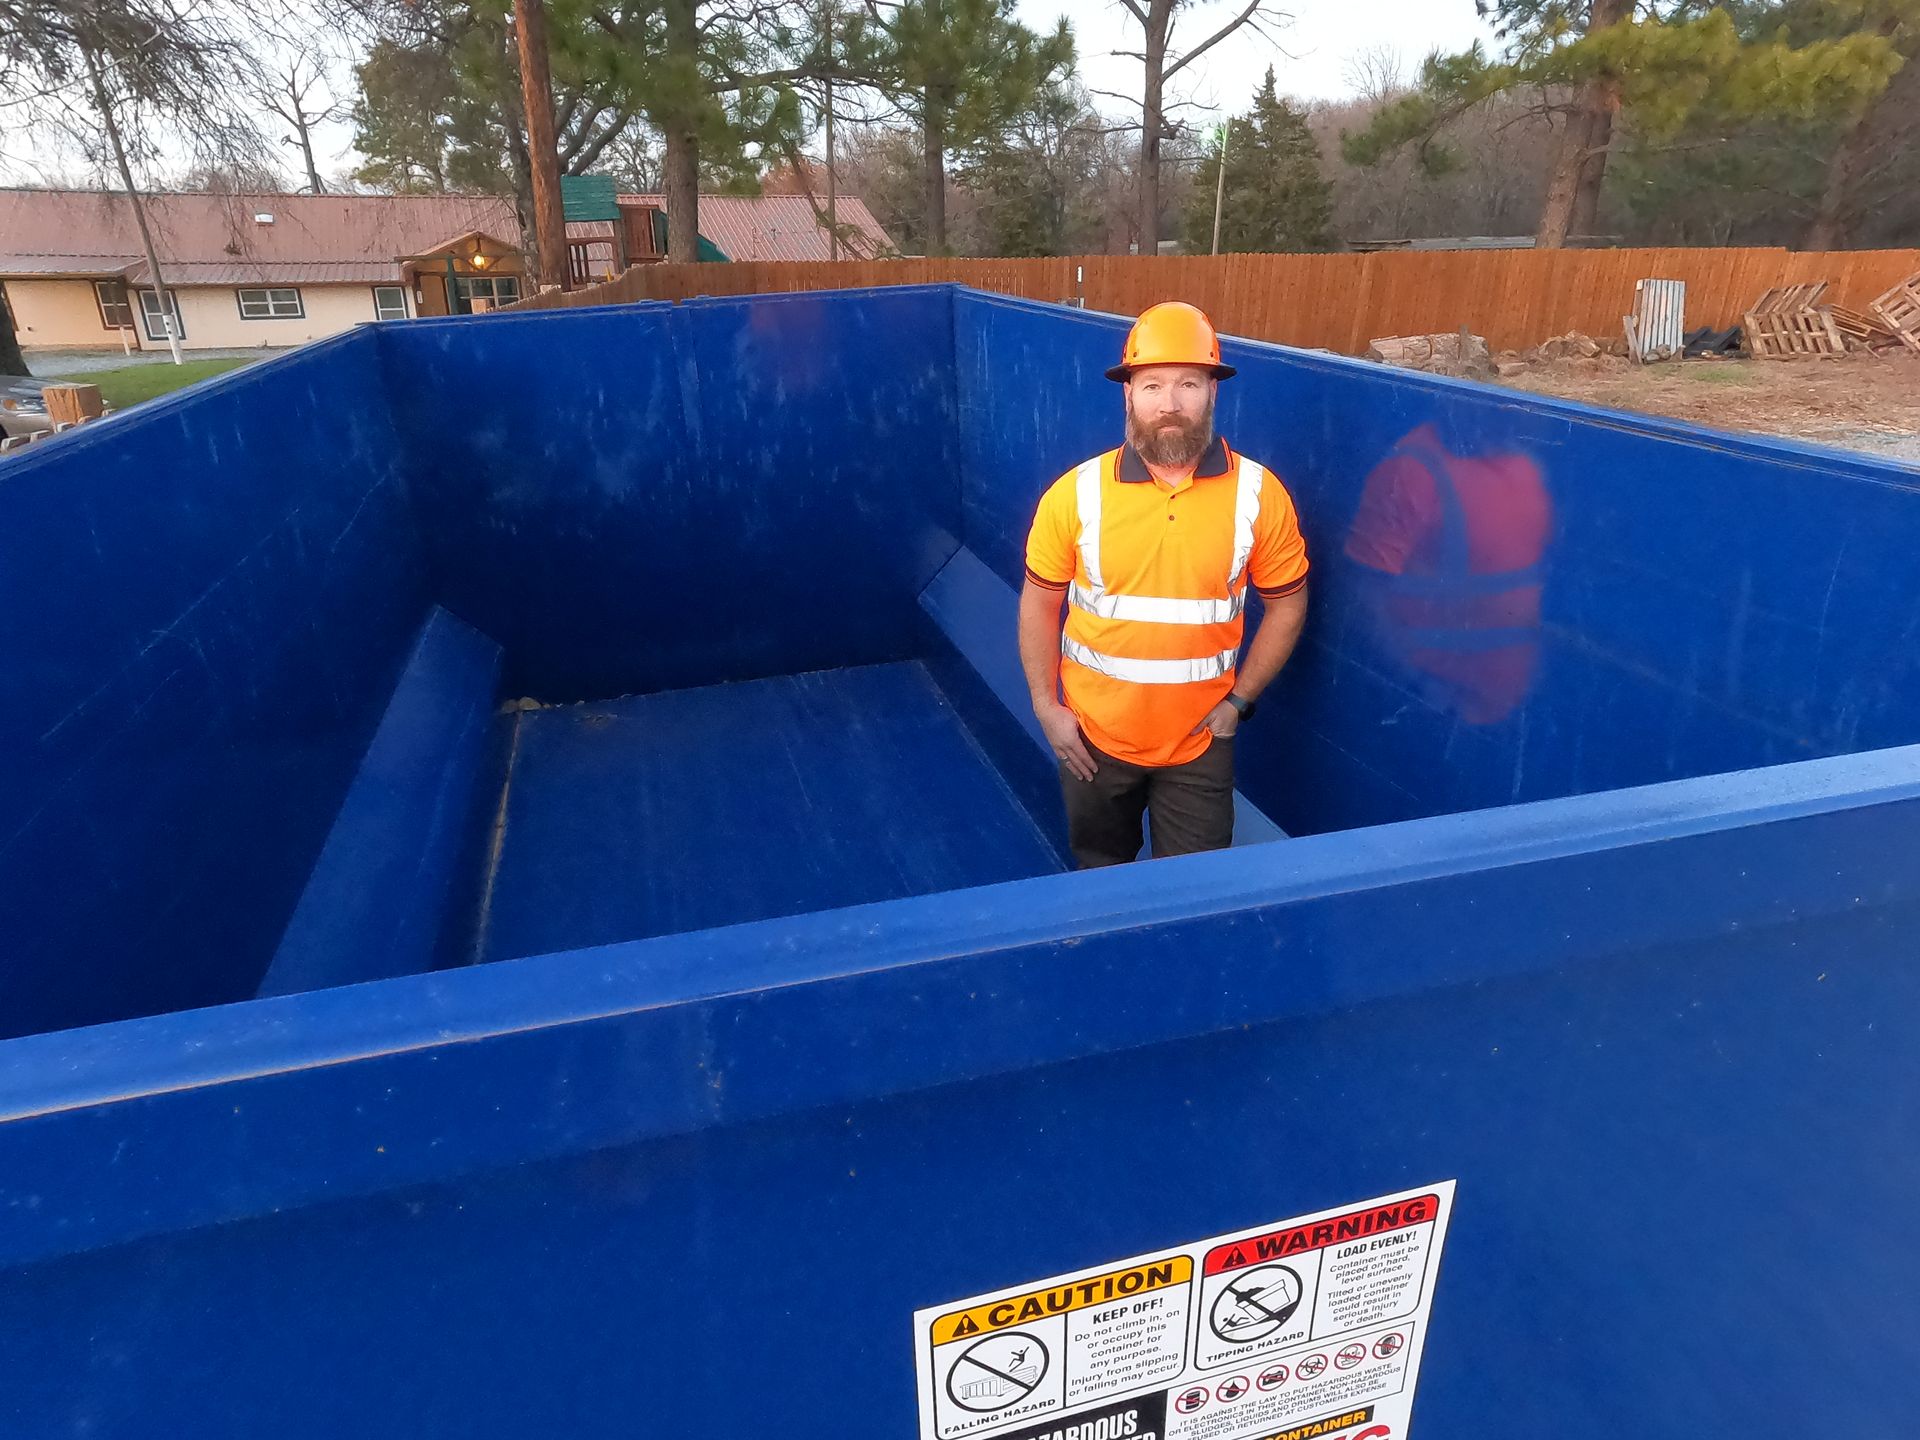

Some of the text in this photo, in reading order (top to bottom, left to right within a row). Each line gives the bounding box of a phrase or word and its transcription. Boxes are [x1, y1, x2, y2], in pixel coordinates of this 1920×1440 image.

[1256, 1201, 1426, 1258] WARNING
[1337, 1231, 1417, 1259] LOAD EVENLY!
[1330, 1256, 1378, 1273] Container
[1381, 1248, 1404, 1260] must
[1336, 1266, 1368, 1280] placed
[1387, 1255, 1410, 1266] hard,
[1328, 1288, 1354, 1299] Tilted
[1370, 1273, 1413, 1288] unevenly
[1342, 1264, 1403, 1285] level surface
[988, 1264, 1172, 1326] CAUTION
[1329, 1282, 1409, 1307] loaded container
[1333, 1301, 1360, 1314] could
[1363, 1295, 1389, 1306] result
[1093, 1298, 1164, 1324] KEEP OFF!
[1333, 1300, 1398, 1322] serious injury
[1357, 1312, 1385, 1323] death.
[1075, 1333, 1090, 1342] Do
[1094, 1327, 1112, 1338] not
[1116, 1318, 1146, 1332] climb
[1103, 1330, 1143, 1345] occupy
[1147, 1324, 1166, 1334] this
[1090, 1346, 1161, 1369] any purpose.
[1091, 1335, 1162, 1358] container for
[1206, 1332, 1304, 1362] TIPPING HAZARD
[1072, 1353, 1178, 1386] Injury from slipping
[1084, 1379, 1117, 1393] falling
[1122, 1372, 1144, 1382] may
[1147, 1362, 1180, 1375] occur.
[1184, 1412, 1244, 1432] ELECTRONICS
[1257, 1402, 1275, 1412] THIS
[1330, 1366, 1400, 1391] NON-HAZARDOUS
[1200, 1406, 1238, 1421] AGAINST
[1241, 1402, 1256, 1411] THE
[1259, 1396, 1277, 1406] LAW
[1293, 1387, 1309, 1395] PUT
[1312, 1372, 1362, 1391] HAZARDOUS
[1365, 1363, 1392, 1375] WASTE
[1236, 1411, 1269, 1424] LIQUIDS
[1271, 1405, 1289, 1414] AND
[1291, 1395, 1321, 1408] DRUMS
[1324, 1390, 1341, 1399] WILL
[1345, 1383, 1366, 1392] ALSO
[944, 1399, 1055, 1434] FALLING HAZARD
[1222, 1425, 1235, 1433] OR
[1238, 1413, 1282, 1429] RETURNED
[1297, 1394, 1348, 1412] CUSTOMERS
[1350, 1383, 1387, 1397] EXPENSE
[1028, 1410, 1137, 1440] RDOUS
